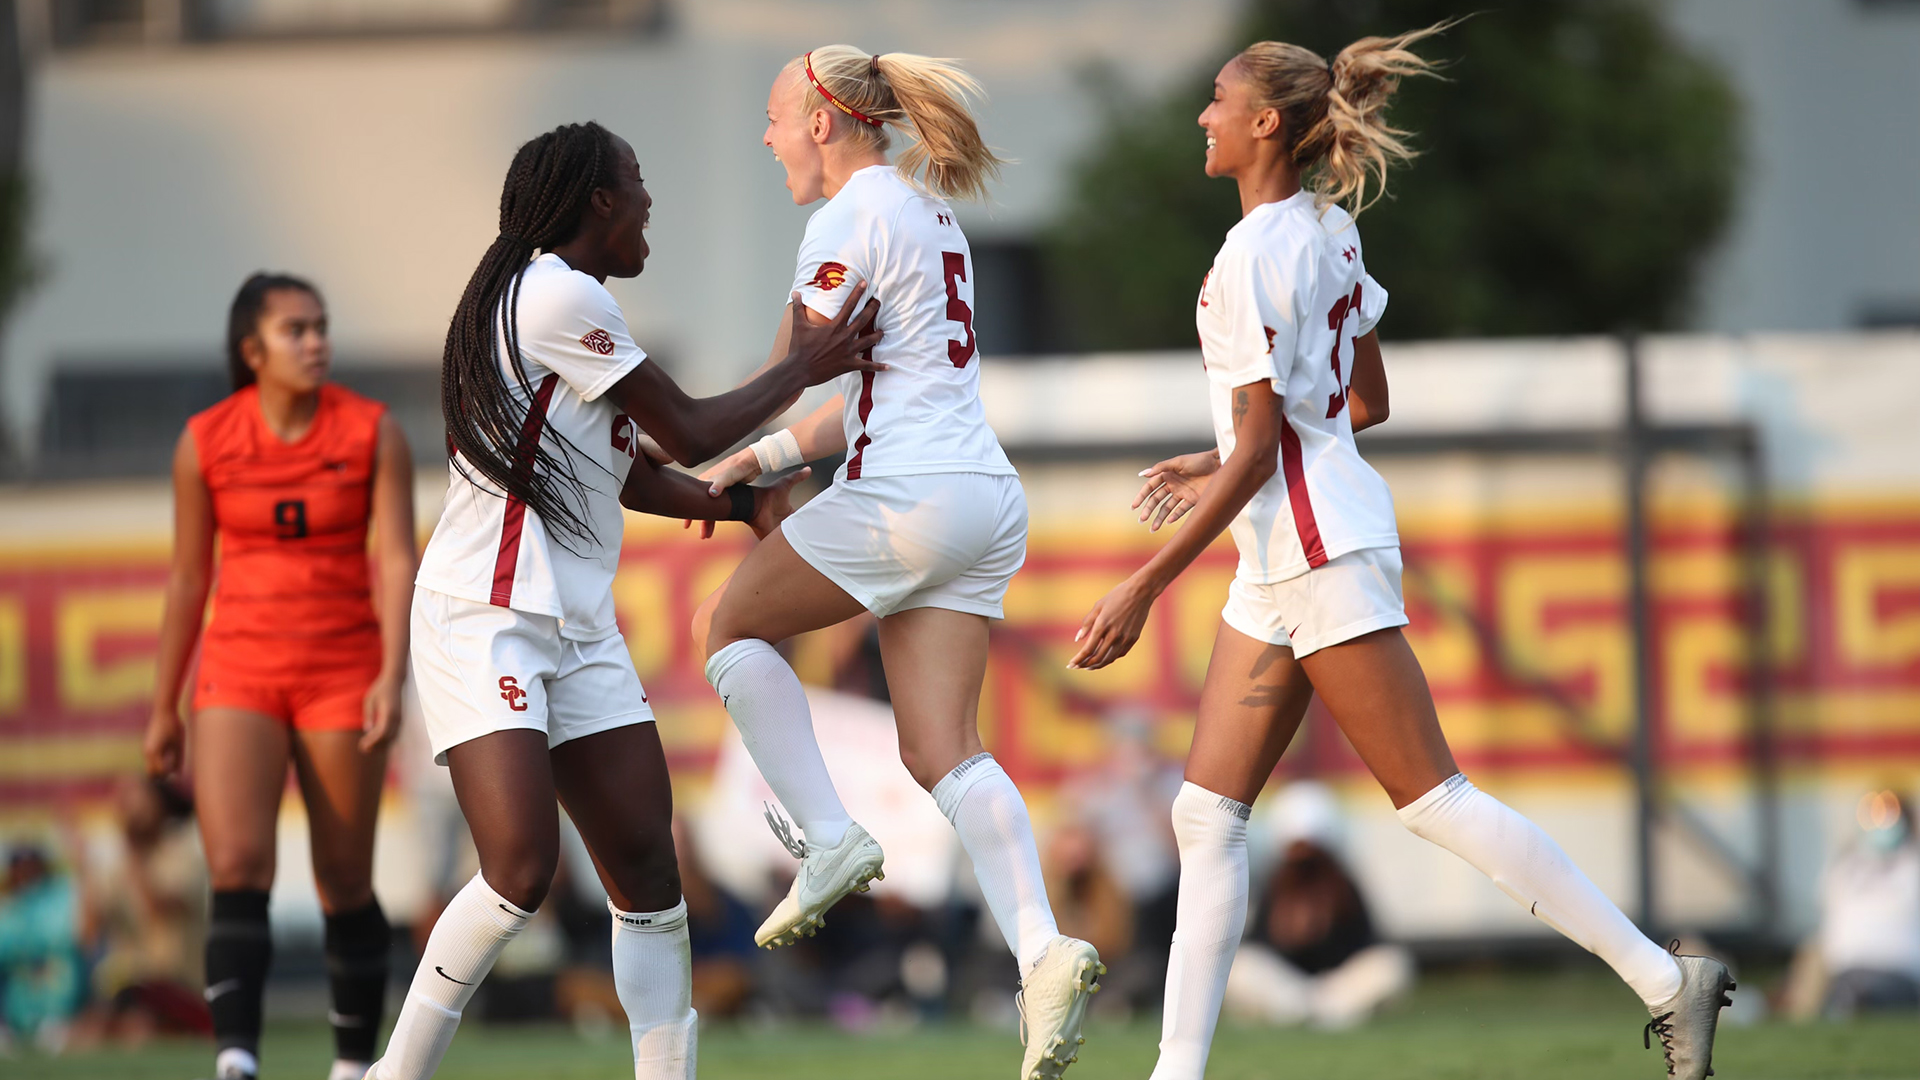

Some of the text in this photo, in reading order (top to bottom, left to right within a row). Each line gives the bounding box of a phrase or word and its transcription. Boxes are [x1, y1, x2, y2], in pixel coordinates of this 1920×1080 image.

[941, 251, 976, 369] 5
[274, 500, 307, 541] 9
[498, 675, 528, 712] SC
[615, 913, 652, 926] GRIP
